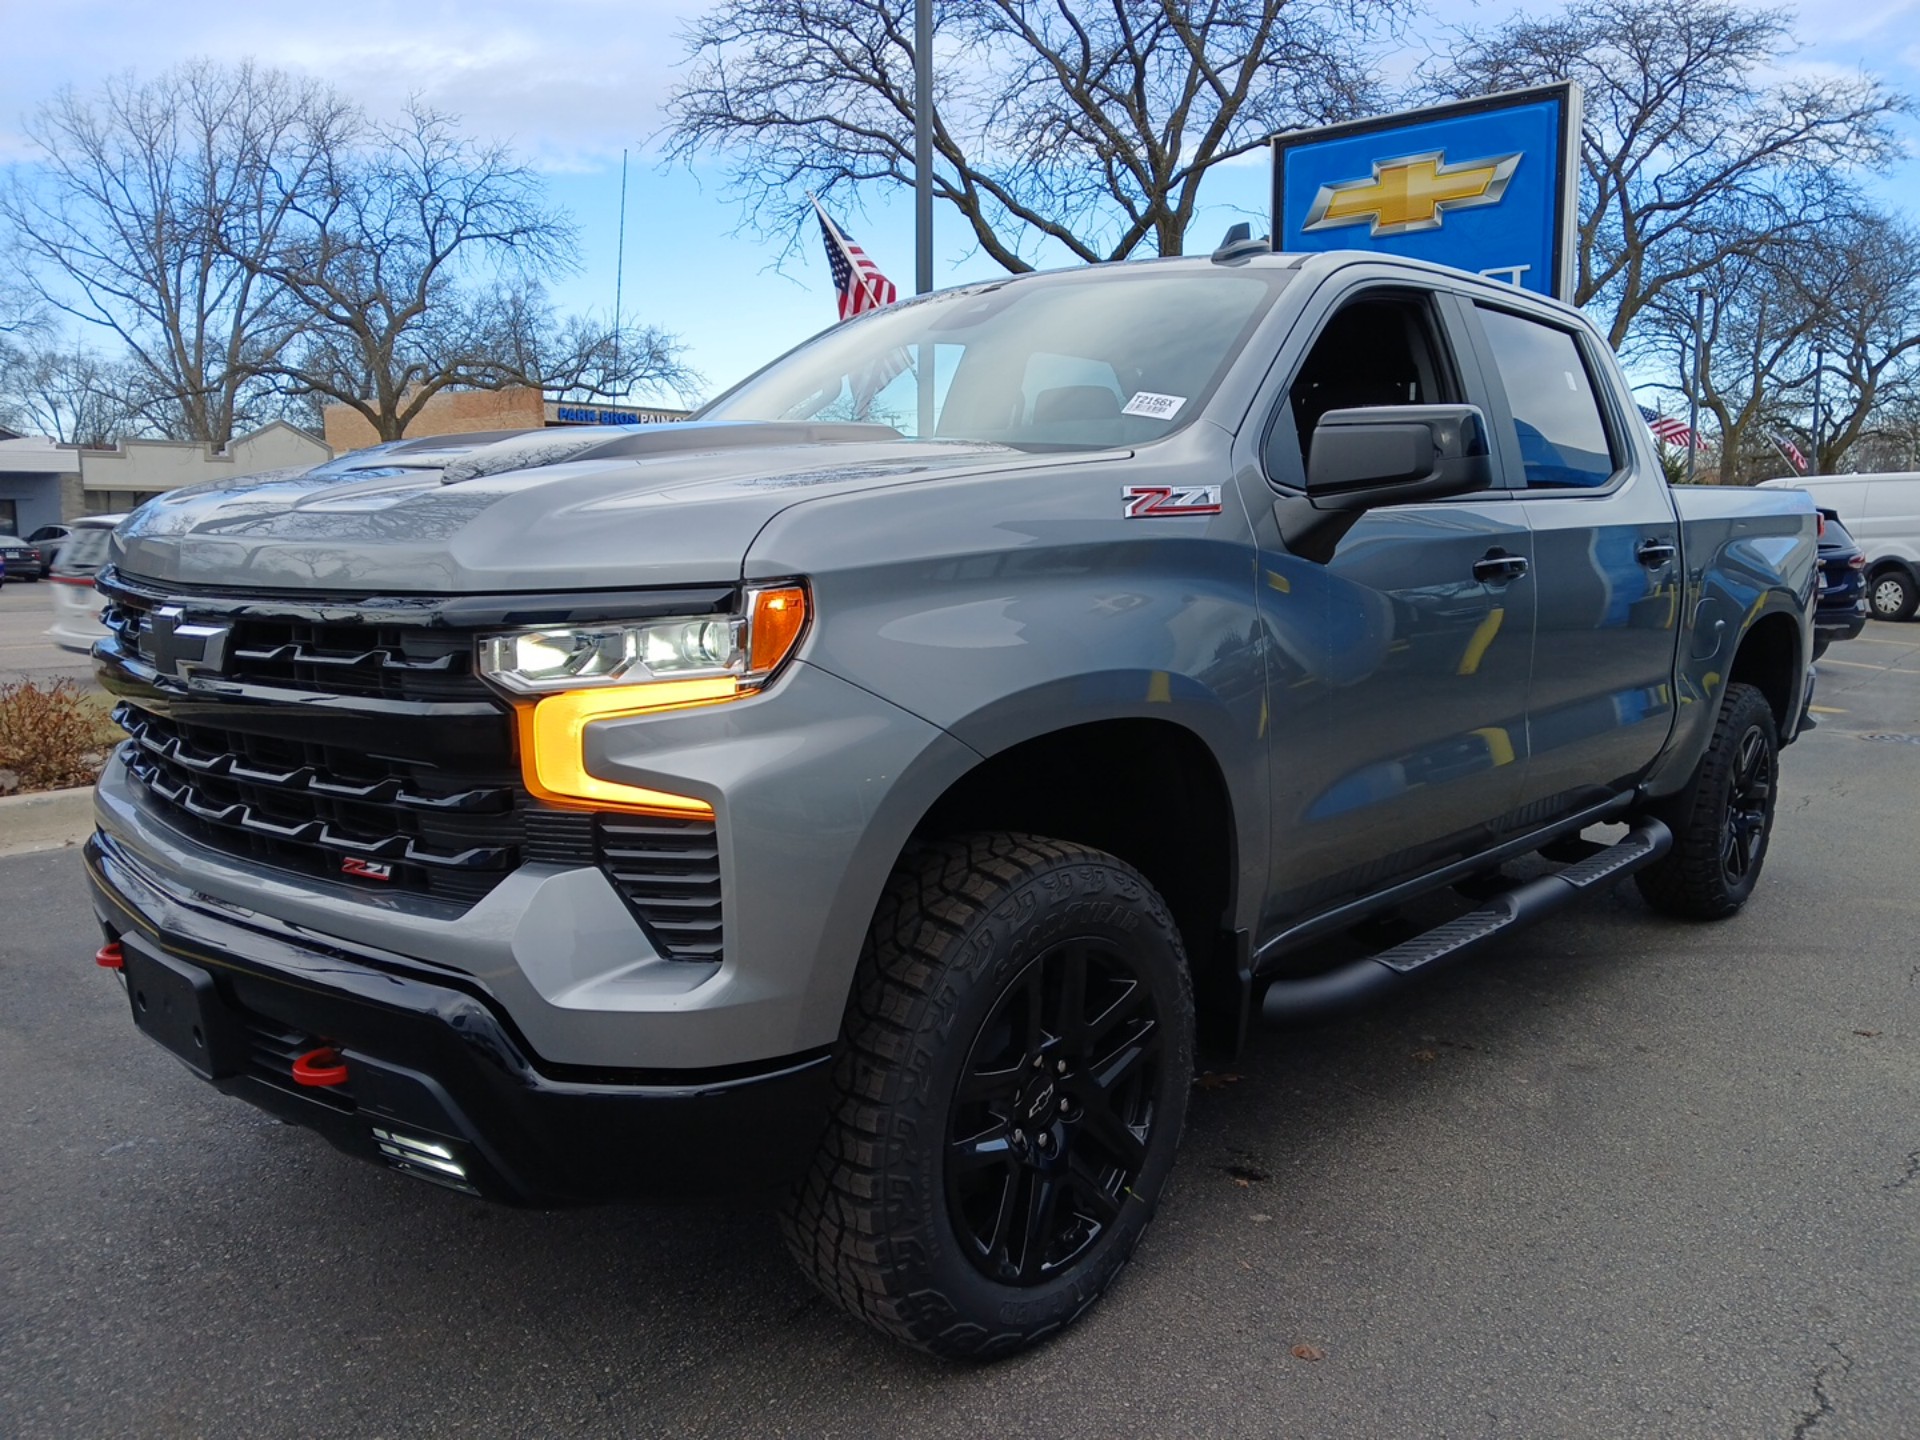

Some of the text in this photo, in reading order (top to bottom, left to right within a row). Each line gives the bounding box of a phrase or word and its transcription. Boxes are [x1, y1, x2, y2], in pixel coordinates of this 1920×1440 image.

[557, 407, 597, 422] PARK
[600, 410, 638, 425] BROS
[1122, 485, 1221, 519] Z71
[342, 856, 392, 881] Z71
[992, 899, 1140, 986] GOODYEAR
